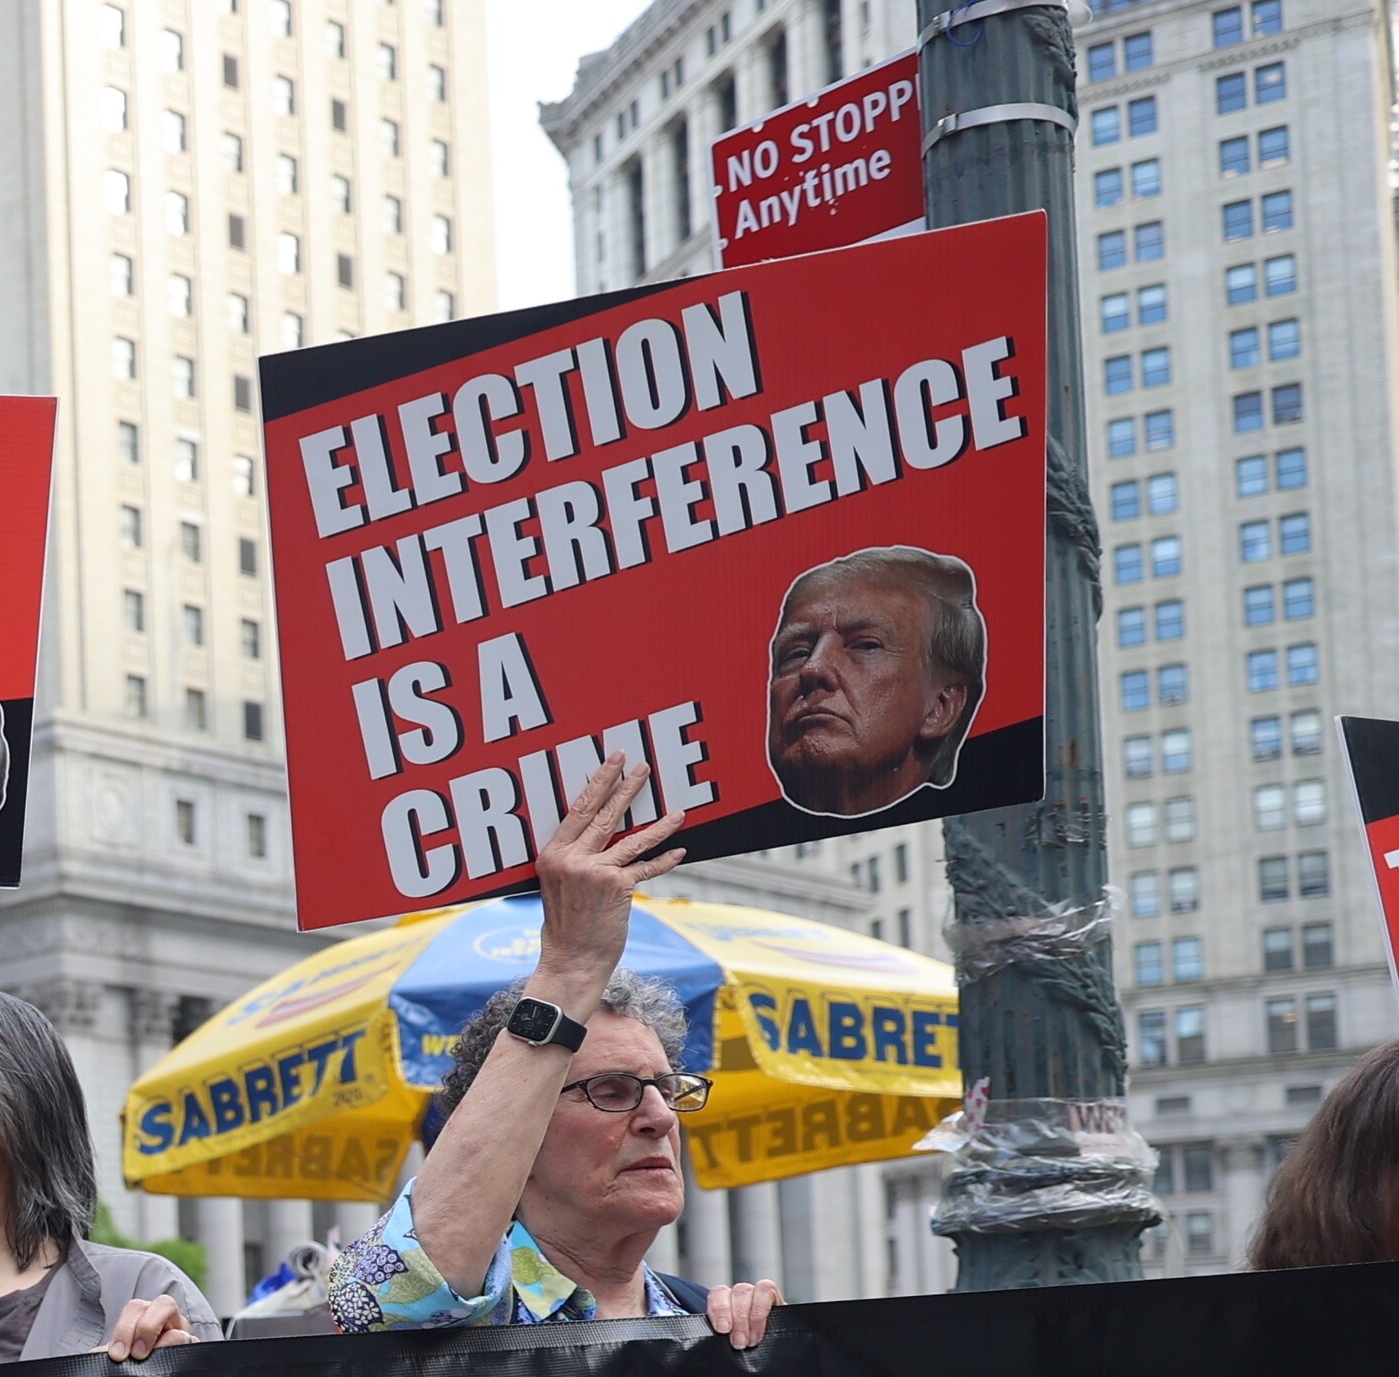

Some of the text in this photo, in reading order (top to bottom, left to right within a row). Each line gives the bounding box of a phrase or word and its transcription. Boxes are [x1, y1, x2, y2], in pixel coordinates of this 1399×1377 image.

[727, 140, 780, 193] NO
[735, 149, 892, 240] Anytime
[299, 290, 759, 540] ELECTION
[325, 336, 1025, 662] INTERFERENCE
[350, 632, 551, 781] IS A
[135, 1030, 367, 1156] SABRETT
